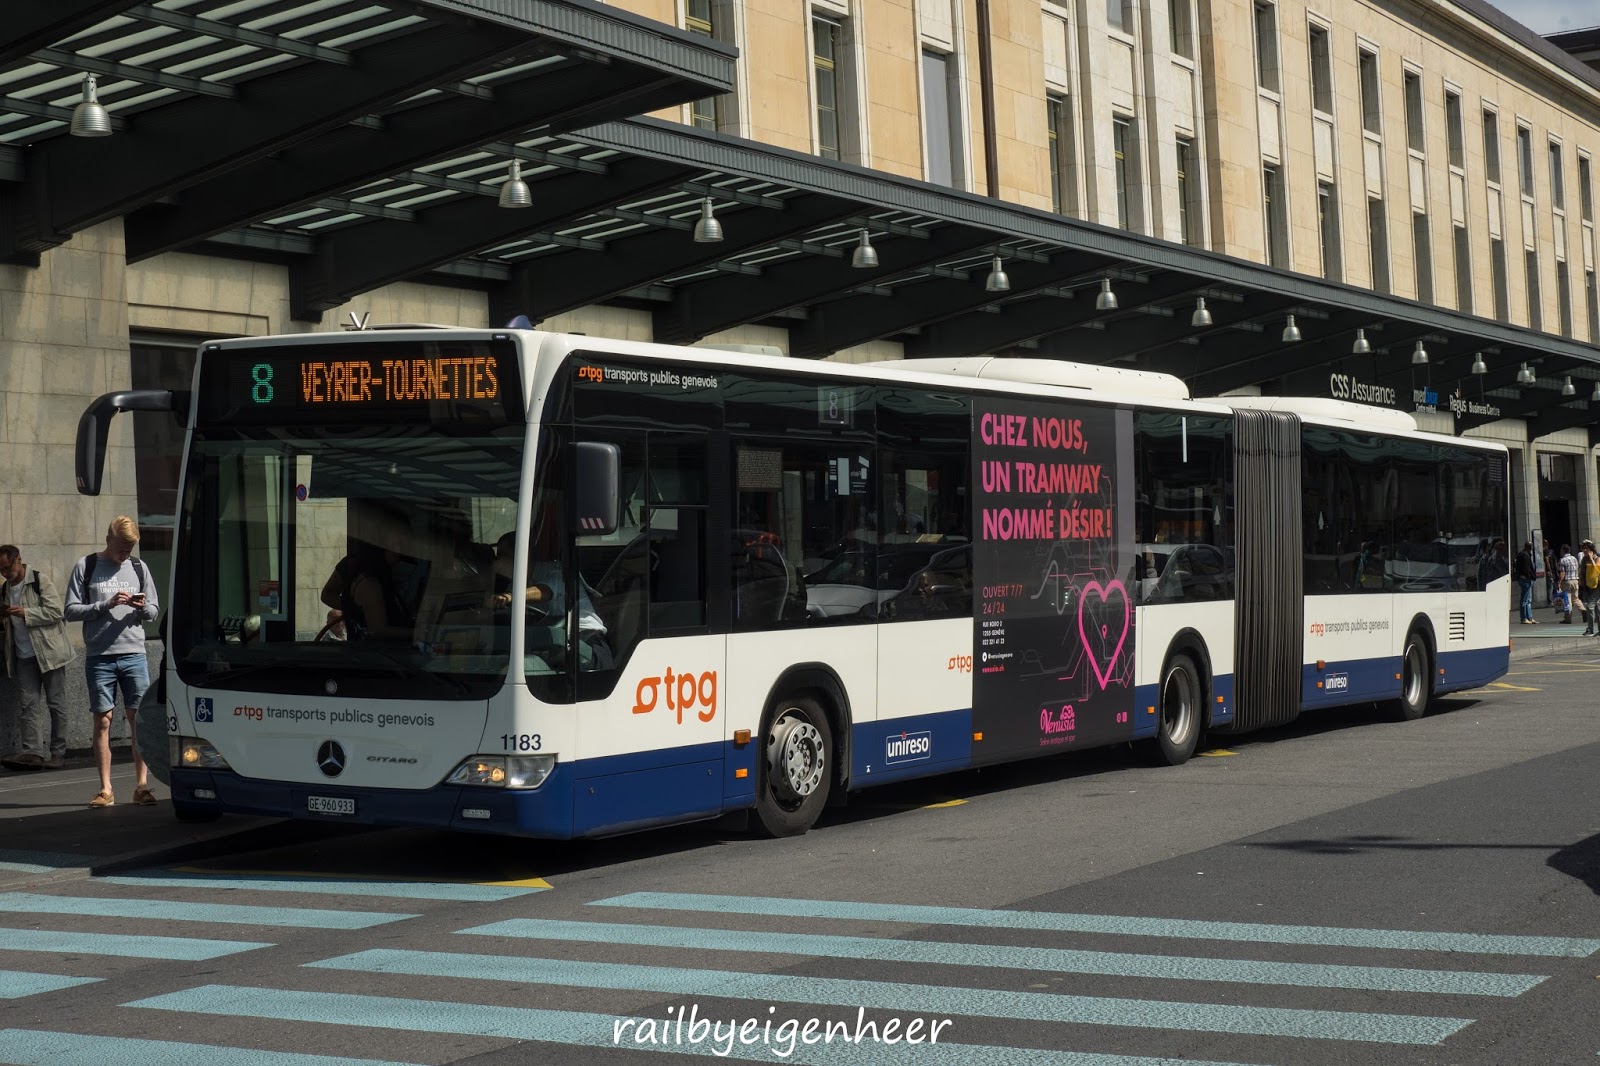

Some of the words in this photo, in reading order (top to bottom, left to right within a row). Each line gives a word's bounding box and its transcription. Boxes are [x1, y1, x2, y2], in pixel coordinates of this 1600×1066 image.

[252, 363, 274, 403] 8
[301, 357, 498, 402] VEYRIER-TOURNETTES
[604, 366, 648, 384] transports
[650, 370, 680, 386] publics
[681, 376, 718, 389] genevois
[1330, 373, 1349, 399] CSS
[1351, 377, 1396, 405] Assurance
[1449, 394, 1467, 419] Regus
[1468, 402, 1487, 414] Business
[1487, 404, 1501, 416] Centre
[980, 412, 1027, 447] CHEZ
[1032, 417, 1088, 454] NOUS,
[982, 461, 1010, 493] UN
[1016, 462, 1101, 494] TRAMWAY
[983, 499, 1054, 540] NOMMÉ
[982, 586, 1009, 598] OUVERT
[1011, 584, 1023, 598] 7/7
[982, 602, 1005, 615] 24/24
[1325, 621, 1350, 635] transports
[1351, 619, 1368, 634] publics
[1369, 618, 1389, 634] genevois
[1325, 676, 1347, 689] unireso
[266, 706, 326, 723] transports
[330, 709, 374, 725] publics
[378, 713, 435, 728] genevois
[1040, 708, 1075, 734] Venusia
[501, 734, 541, 751] 1183
[887, 736, 929, 758] unireso
[366, 756, 418, 764] CITARO
